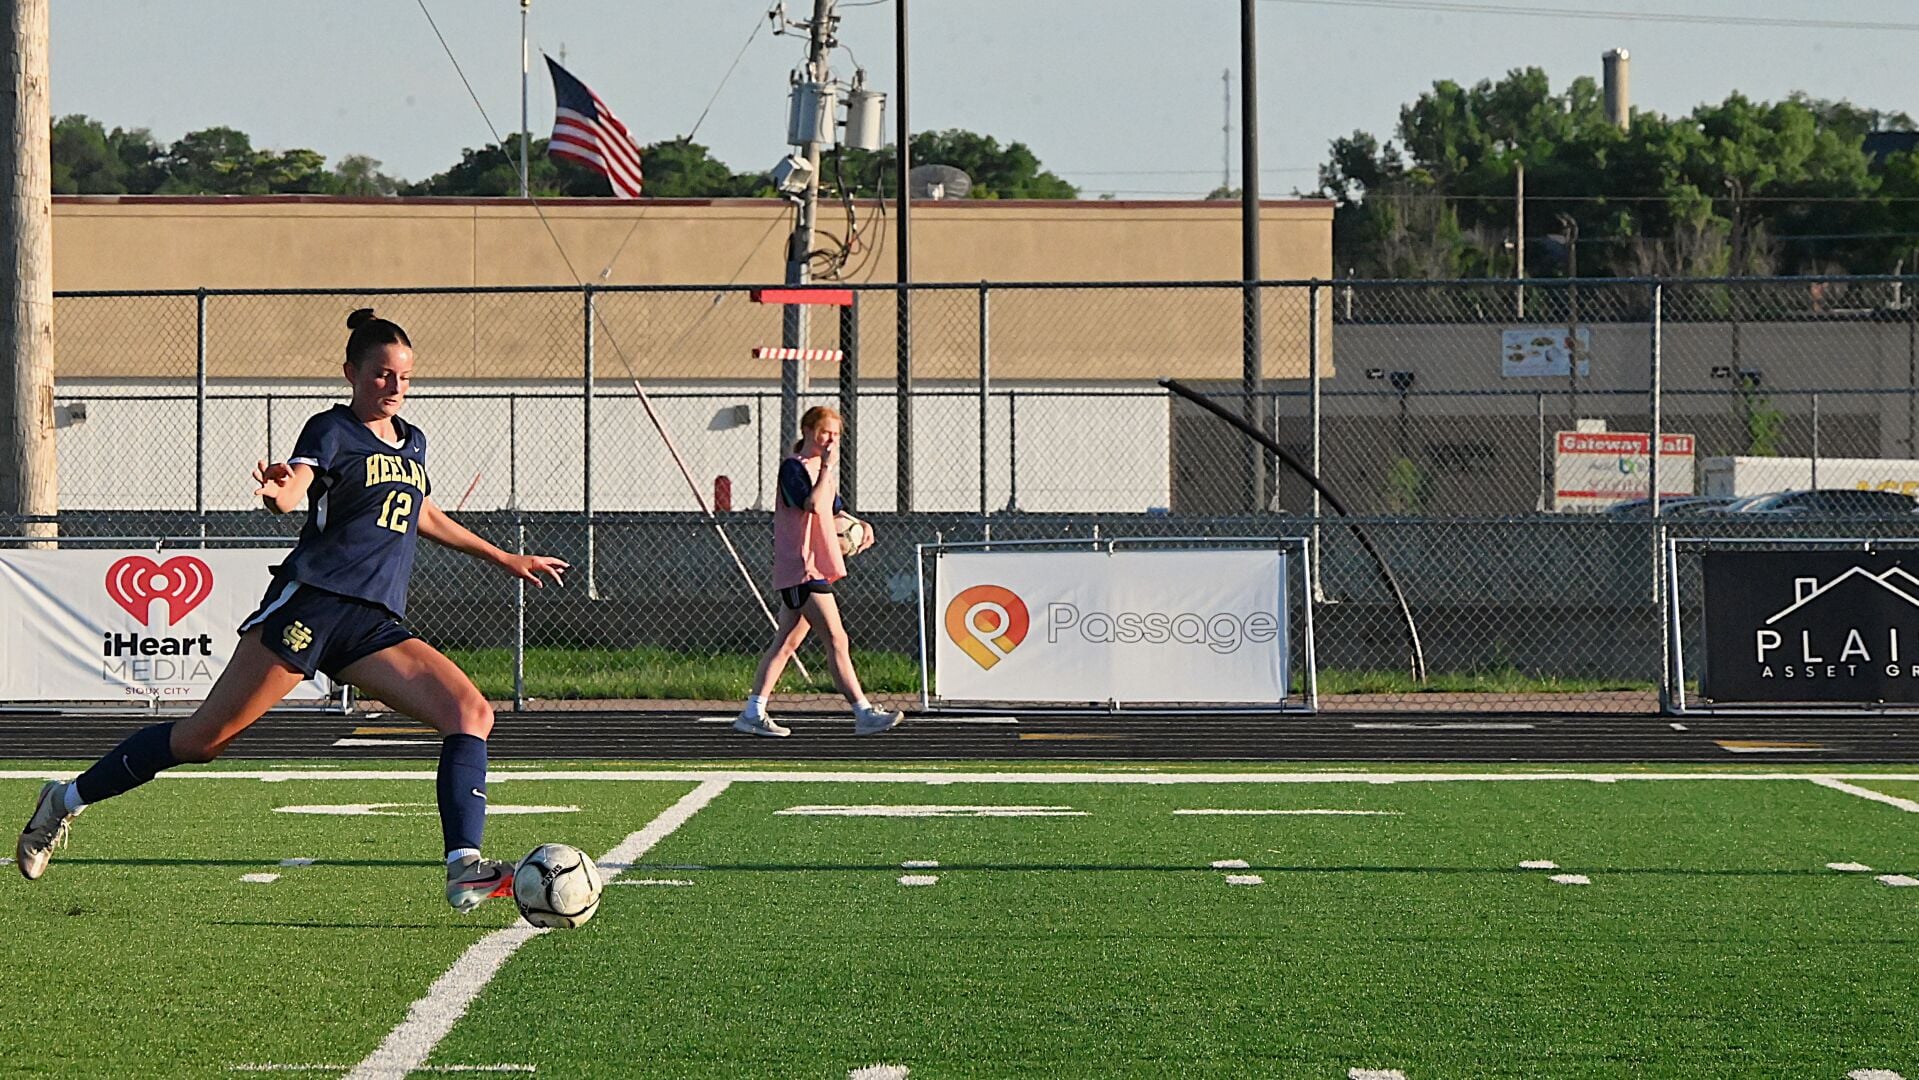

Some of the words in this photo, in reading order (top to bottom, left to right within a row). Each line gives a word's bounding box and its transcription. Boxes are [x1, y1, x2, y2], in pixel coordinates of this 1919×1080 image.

[1563, 436, 1641, 453] Gateway
[376, 490, 412, 534] 12
[1048, 602, 1279, 654] Passage
[104, 632, 212, 656] iHeart
[1757, 628, 1899, 663] PLAI
[103, 659, 213, 681] MEDIA
[1762, 665, 1857, 677] ASSET
[1885, 664, 1919, 677] GR
[125, 687, 160, 695] SIOUX
[163, 687, 191, 695] CITY
